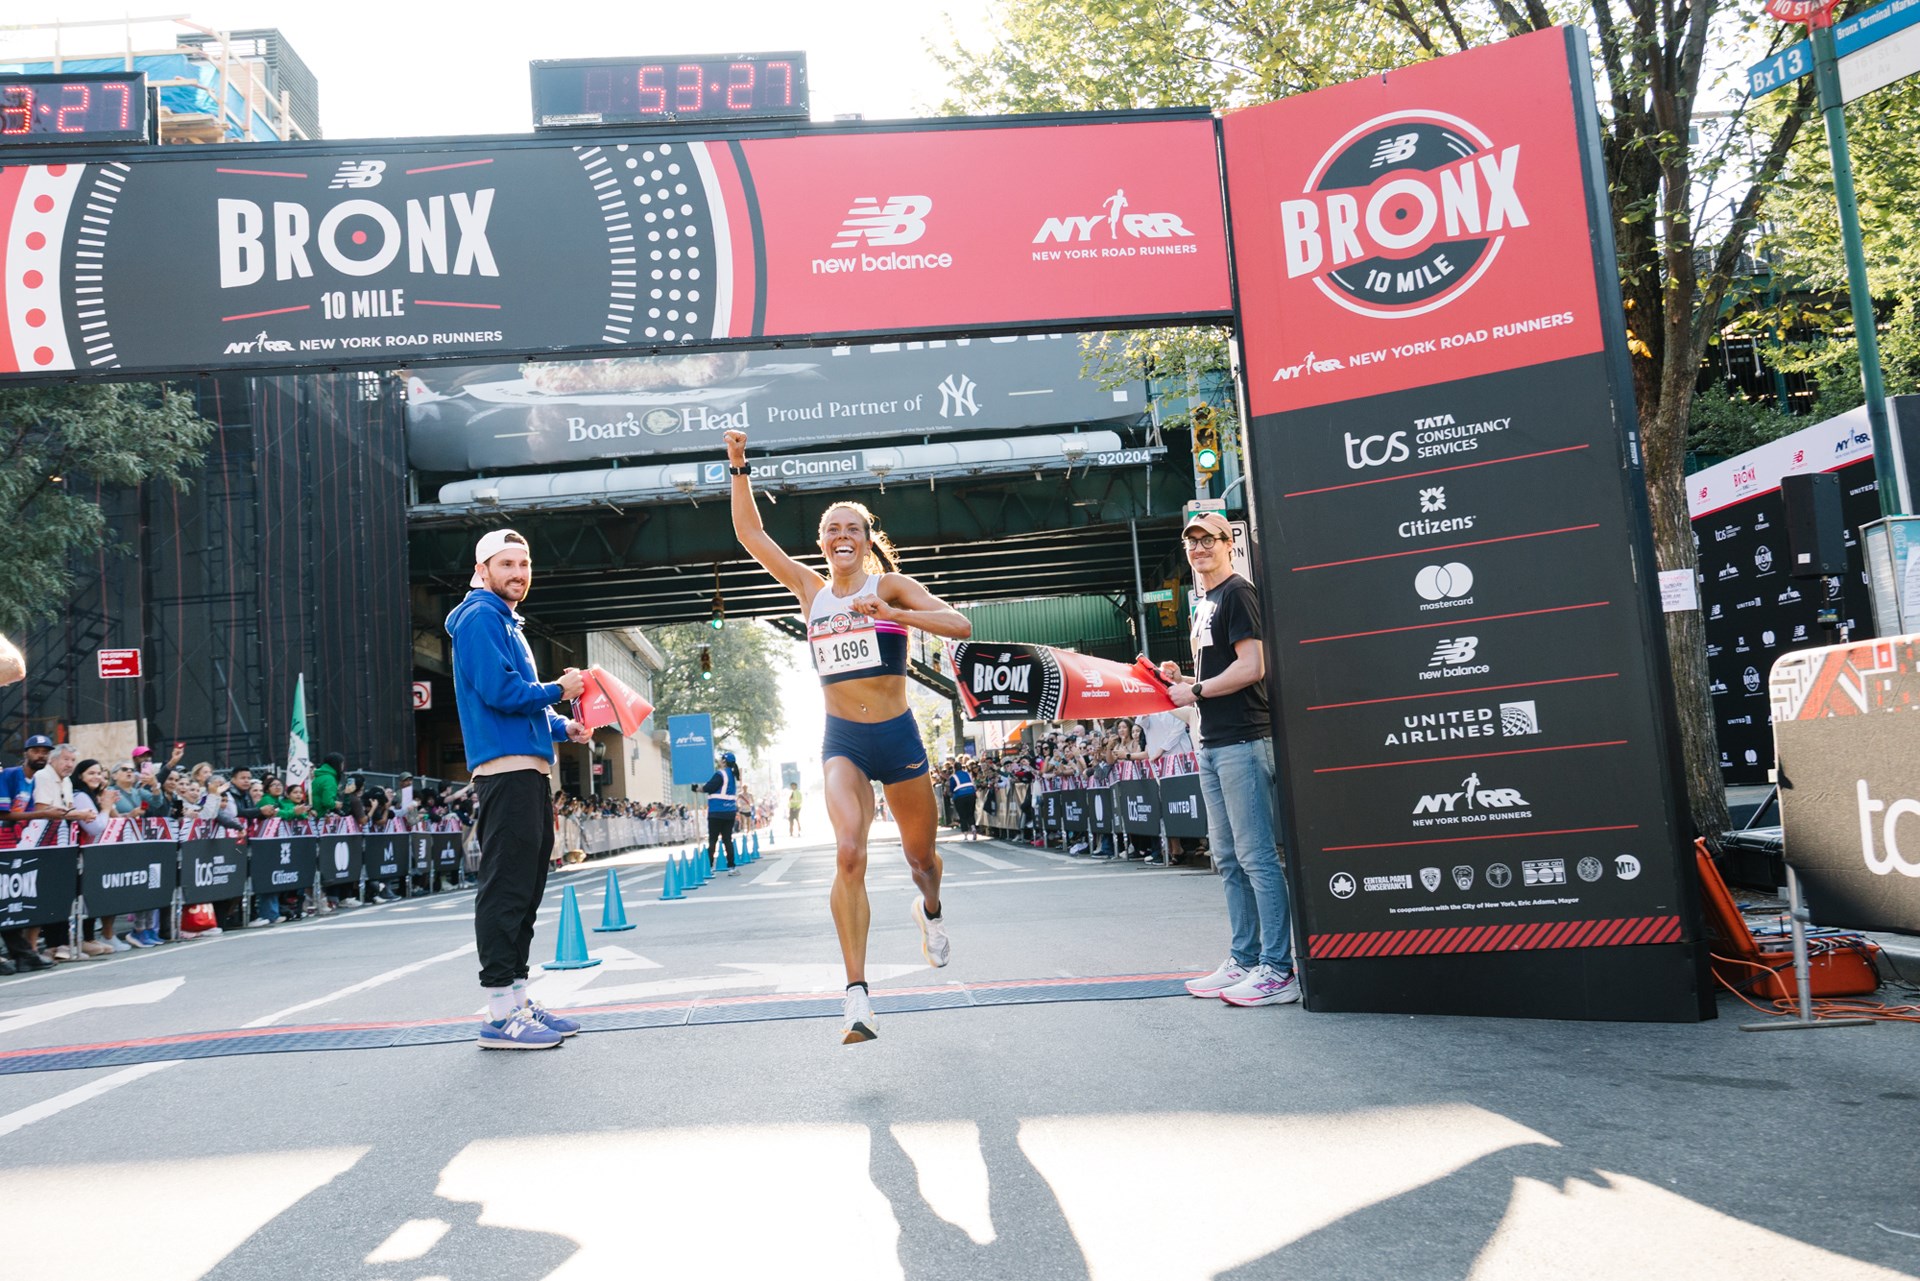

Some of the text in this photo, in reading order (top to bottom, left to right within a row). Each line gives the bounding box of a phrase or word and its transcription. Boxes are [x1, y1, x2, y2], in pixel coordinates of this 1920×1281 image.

[1837, 6, 1891, 41] Bronx Terminal
[1752, 49, 1804, 93] Bx13
[1279, 144, 1530, 280] BRONX
[217, 188, 500, 289] BRONX
[811, 252, 953, 274] new balance
[1032, 244, 1198, 261] NEW YORK ROAD RUNNERS
[1363, 253, 1455, 293] 10 MILE
[320, 289, 405, 320] 10 MILE
[300, 339, 336, 351] NEW
[339, 337, 382, 349] YORK
[385, 335, 429, 347] ROAD
[432, 331, 503, 344] RUNNERS
[1348, 348, 1387, 367] NEW
[1392, 340, 1437, 361] YORK
[1440, 329, 1489, 352] ROAD
[1492, 311, 1574, 341] RUNNERS
[767, 393, 924, 423] Proud Partner of
[566, 402, 749, 442] Boar's Head
[1414, 413, 1456, 430] TATA
[1415, 417, 1512, 445] CONSULTANCY
[1098, 449, 1152, 466] 920204
[1344, 431, 1410, 470] tcs
[1417, 438, 1479, 459] SERVICES
[781, 455, 858, 475] Channel
[1849, 483, 1874, 496] UNITED
[1398, 515, 1477, 538] Citizens
[1419, 597, 1474, 611] mastercard
[833, 639, 869, 662] 1696
[973, 662, 1032, 694] BRONX
[1418, 664, 1490, 680] new balance
[1404, 708, 1494, 728] UNITED
[1384, 724, 1496, 746] AIRLINES
[1168, 800, 1190, 814] UNITED
[1412, 811, 1533, 827] NEW YORK ROAD RUNNERS
[194, 858, 213, 887] tcs
[1616, 861, 1637, 875] MTA
[0, 869, 38, 900] RONX
[102, 870, 148, 889] UNITED
[1363, 874, 1406, 885] CENTRAL PARK
[1364, 883, 1407, 892] CONSERVANCY
[1397, 906, 1435, 914] cooperation
[1462, 903, 1476, 911] City
[1532, 898, 1558, 906] Adams,
[1558, 898, 1580, 906] Mayor
